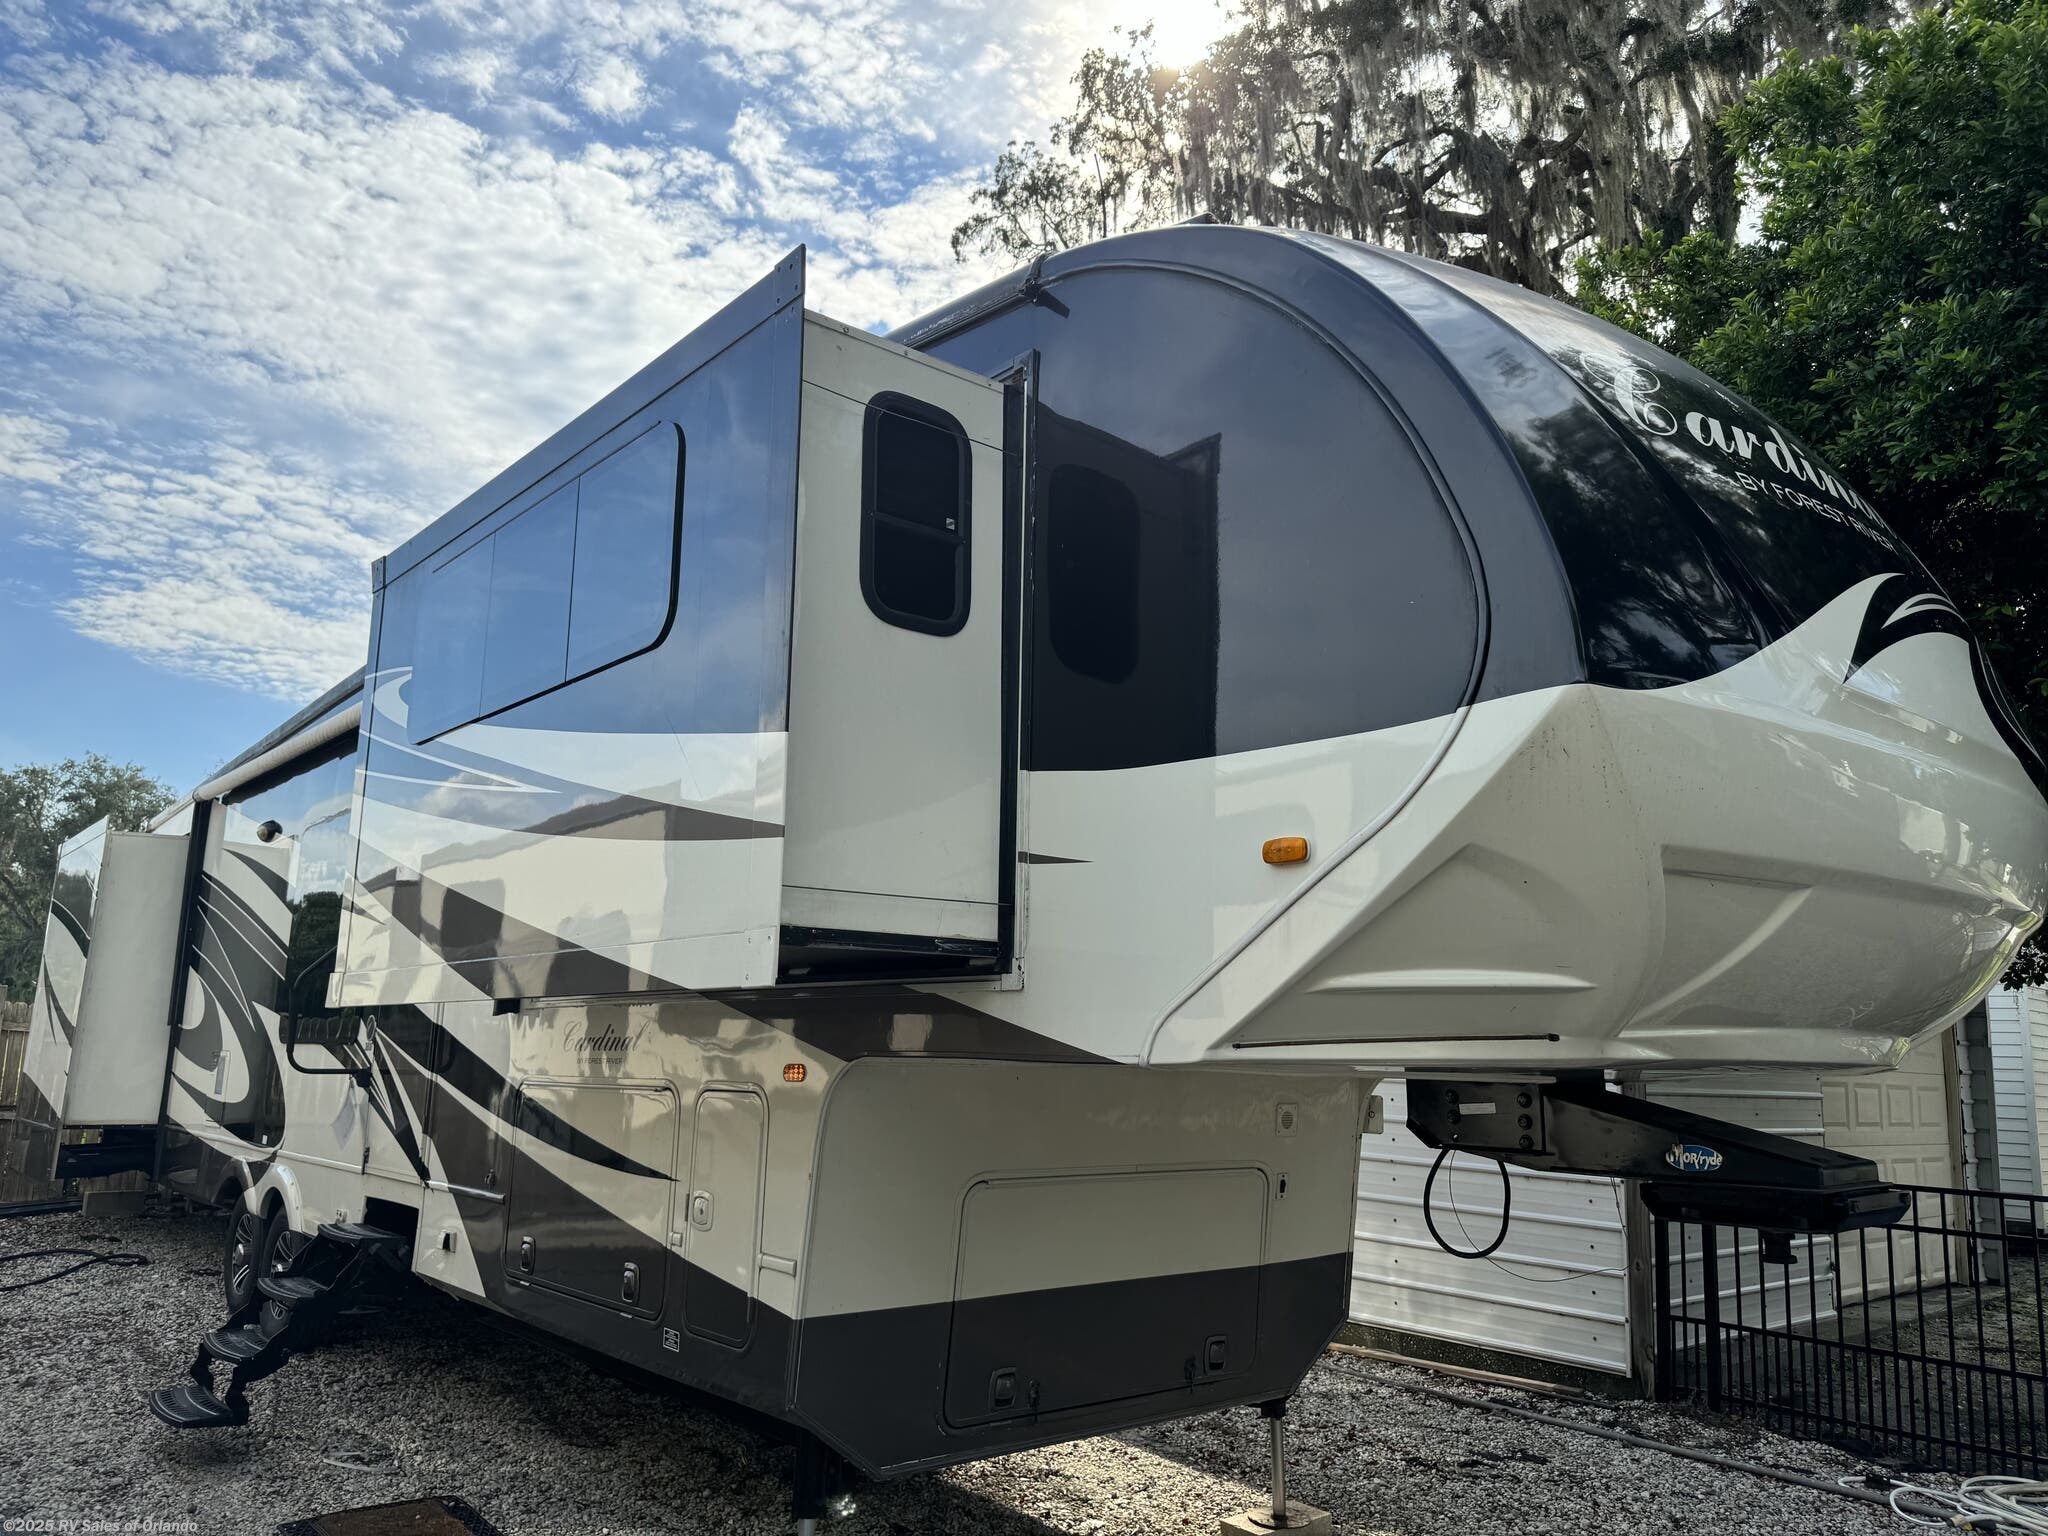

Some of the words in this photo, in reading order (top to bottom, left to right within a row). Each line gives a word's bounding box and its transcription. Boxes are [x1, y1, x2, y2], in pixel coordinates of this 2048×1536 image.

[1735, 471, 1768, 495] BY
[1770, 481, 1850, 527] FOREST
[1847, 515, 1899, 556] RIVER
[563, 1020, 651, 1053] Cardinal
